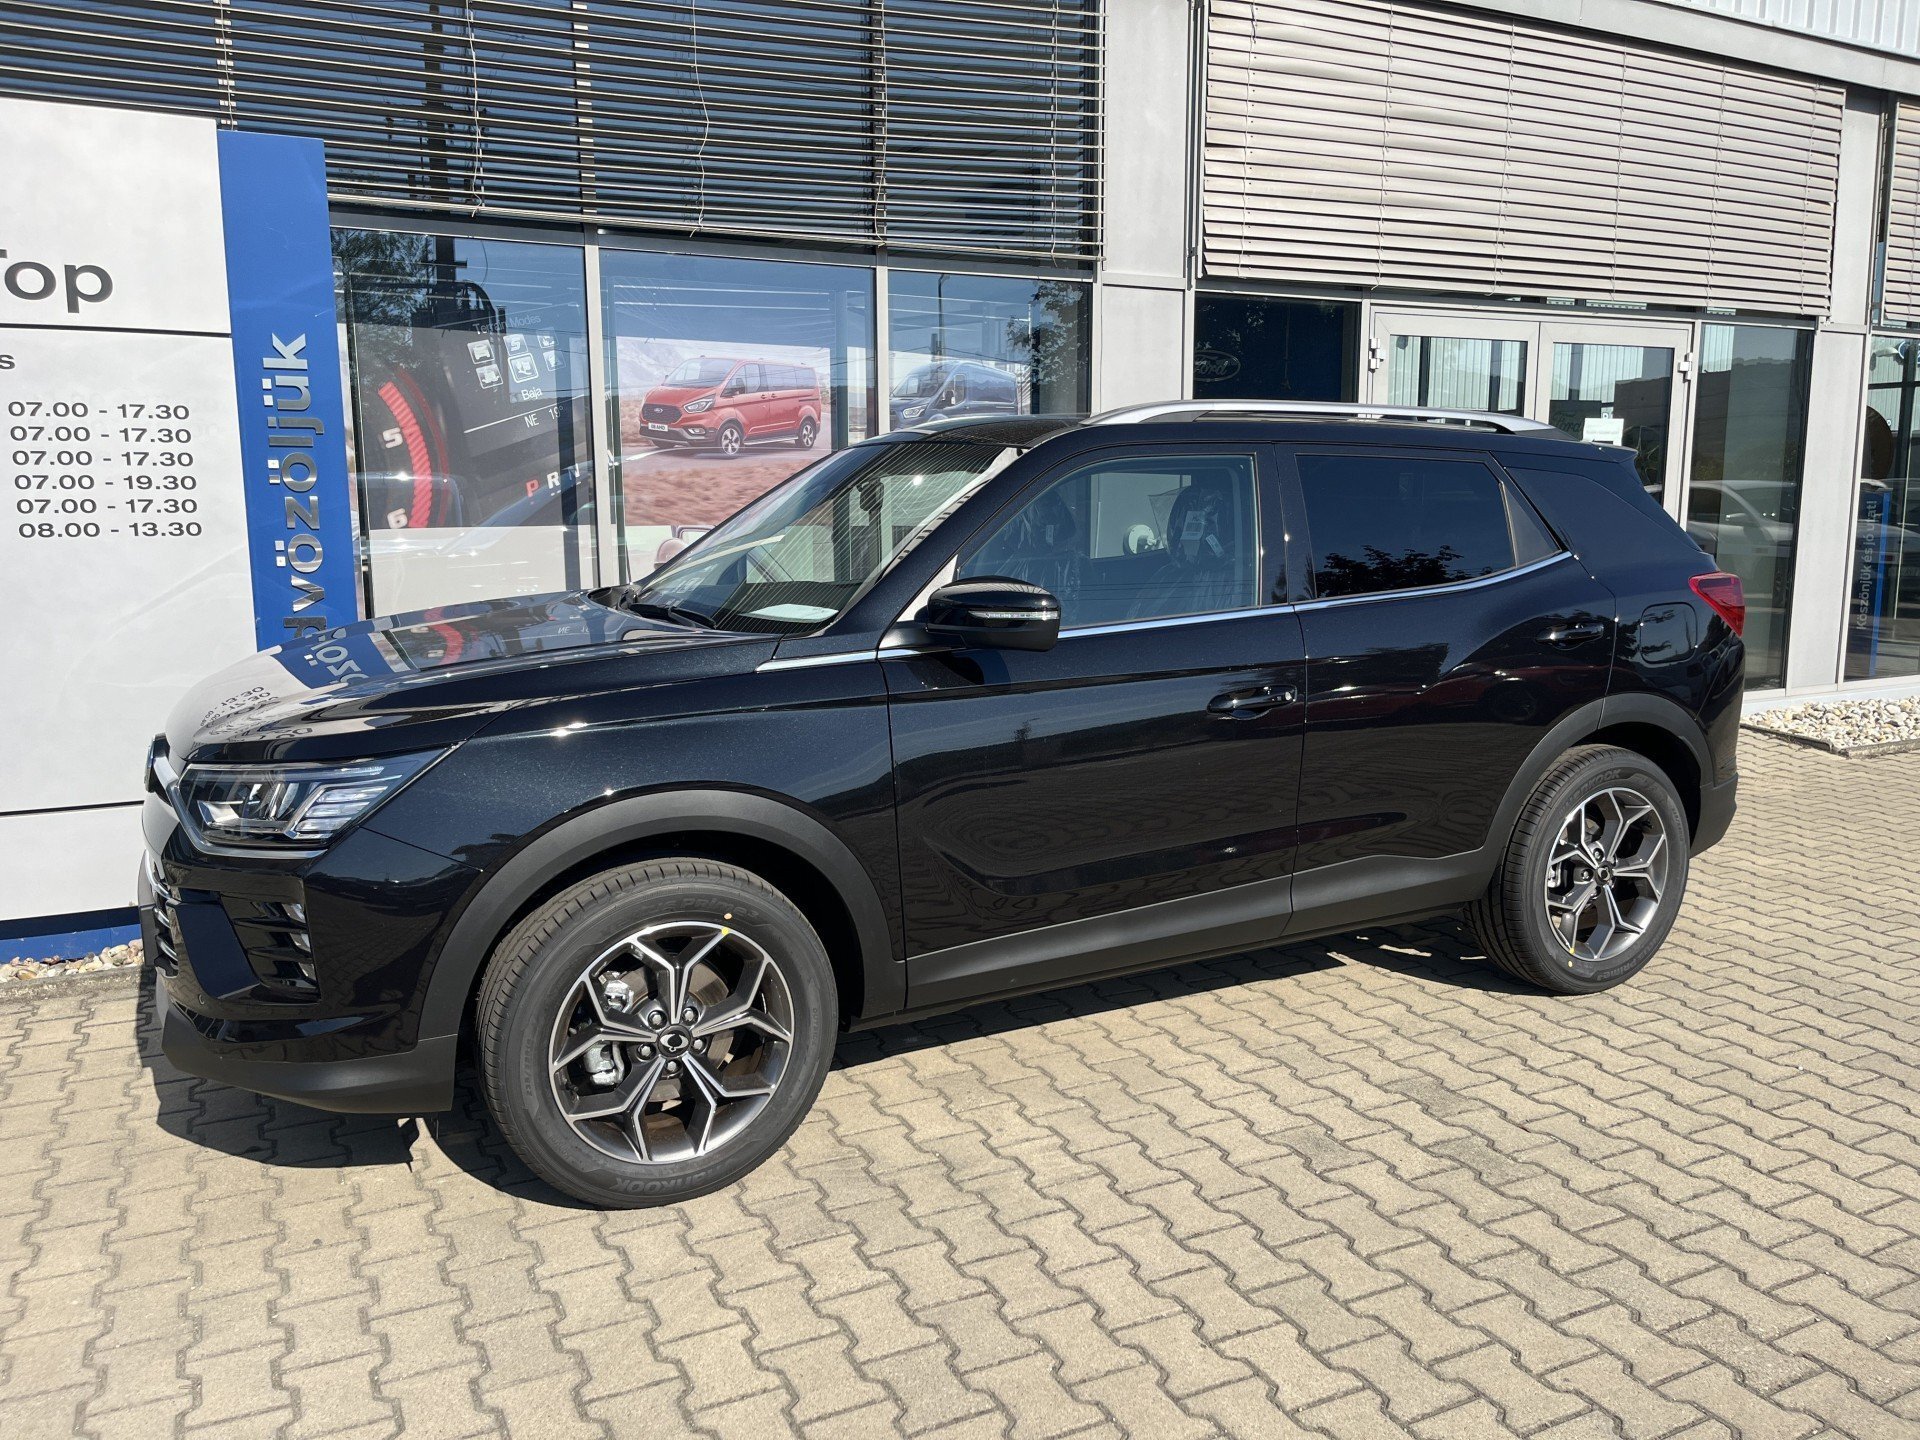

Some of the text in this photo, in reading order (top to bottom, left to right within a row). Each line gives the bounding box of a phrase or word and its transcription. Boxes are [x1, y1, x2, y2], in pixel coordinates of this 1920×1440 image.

[0, 249, 113, 314] op
[521, 387, 543, 401] Baja
[8, 401, 89, 418] 07.00
[117, 403, 190, 420] 17.30
[524, 413, 540, 428] NE
[10, 425, 91, 442] 07.00
[119, 427, 192, 444] 17.30
[12, 450, 93, 466] 07.00
[121, 451, 194, 467] 17.30
[14, 474, 95, 490] 07.00
[123, 475, 197, 491] 19.30
[262, 333, 326, 638] dvözöljük
[526, 479, 540, 497] P
[547, 472, 561, 489] R
[16, 498, 97, 514] 07.00
[125, 498, 198, 514] 17.30
[18, 522, 101, 538] 08.00
[128, 521, 202, 537] 13.30
